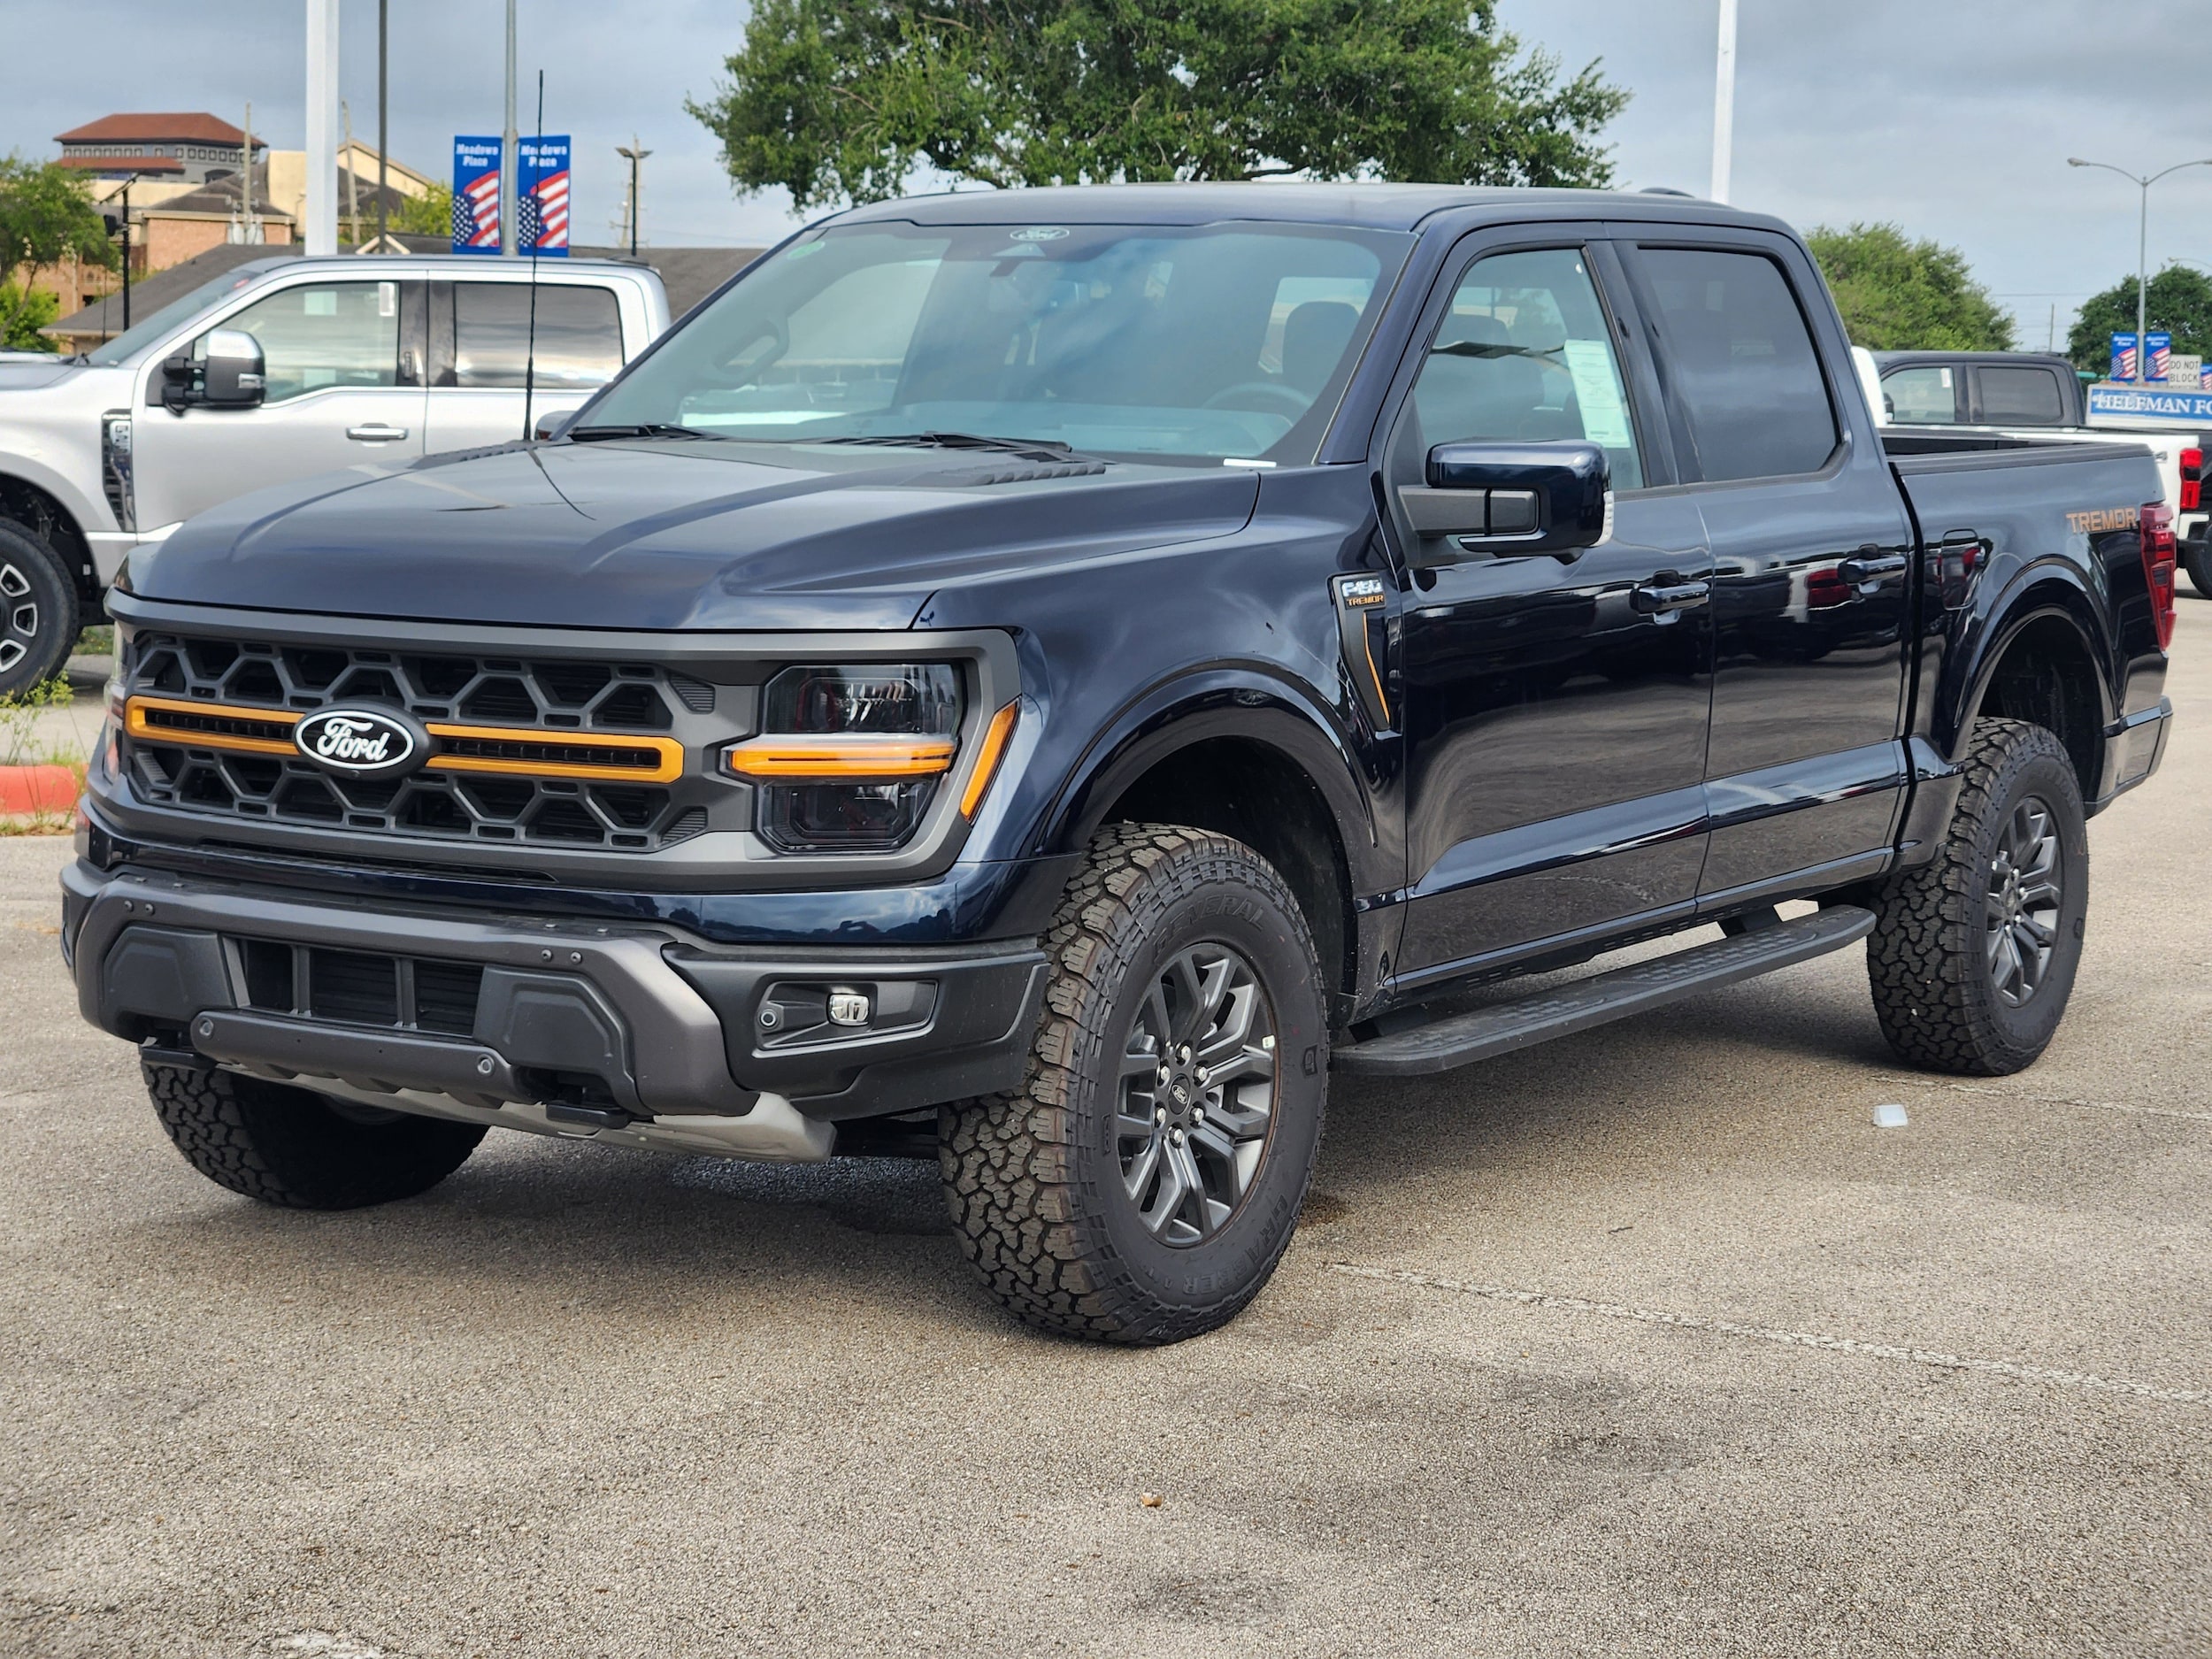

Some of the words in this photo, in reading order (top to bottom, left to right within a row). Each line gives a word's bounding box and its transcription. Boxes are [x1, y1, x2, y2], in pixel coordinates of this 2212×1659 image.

[528, 156, 557, 167] Pace
[2170, 360, 2181, 370] DO
[2184, 361, 2199, 370] NOT
[2170, 373, 2199, 383] BLOCK
[2094, 395, 2191, 413] HELFMAN
[2066, 507, 2138, 534] TREMOR
[1347, 595, 1384, 606] TREMOR
[317, 717, 391, 762] Ford
[1153, 894, 1264, 961] GENERAL
